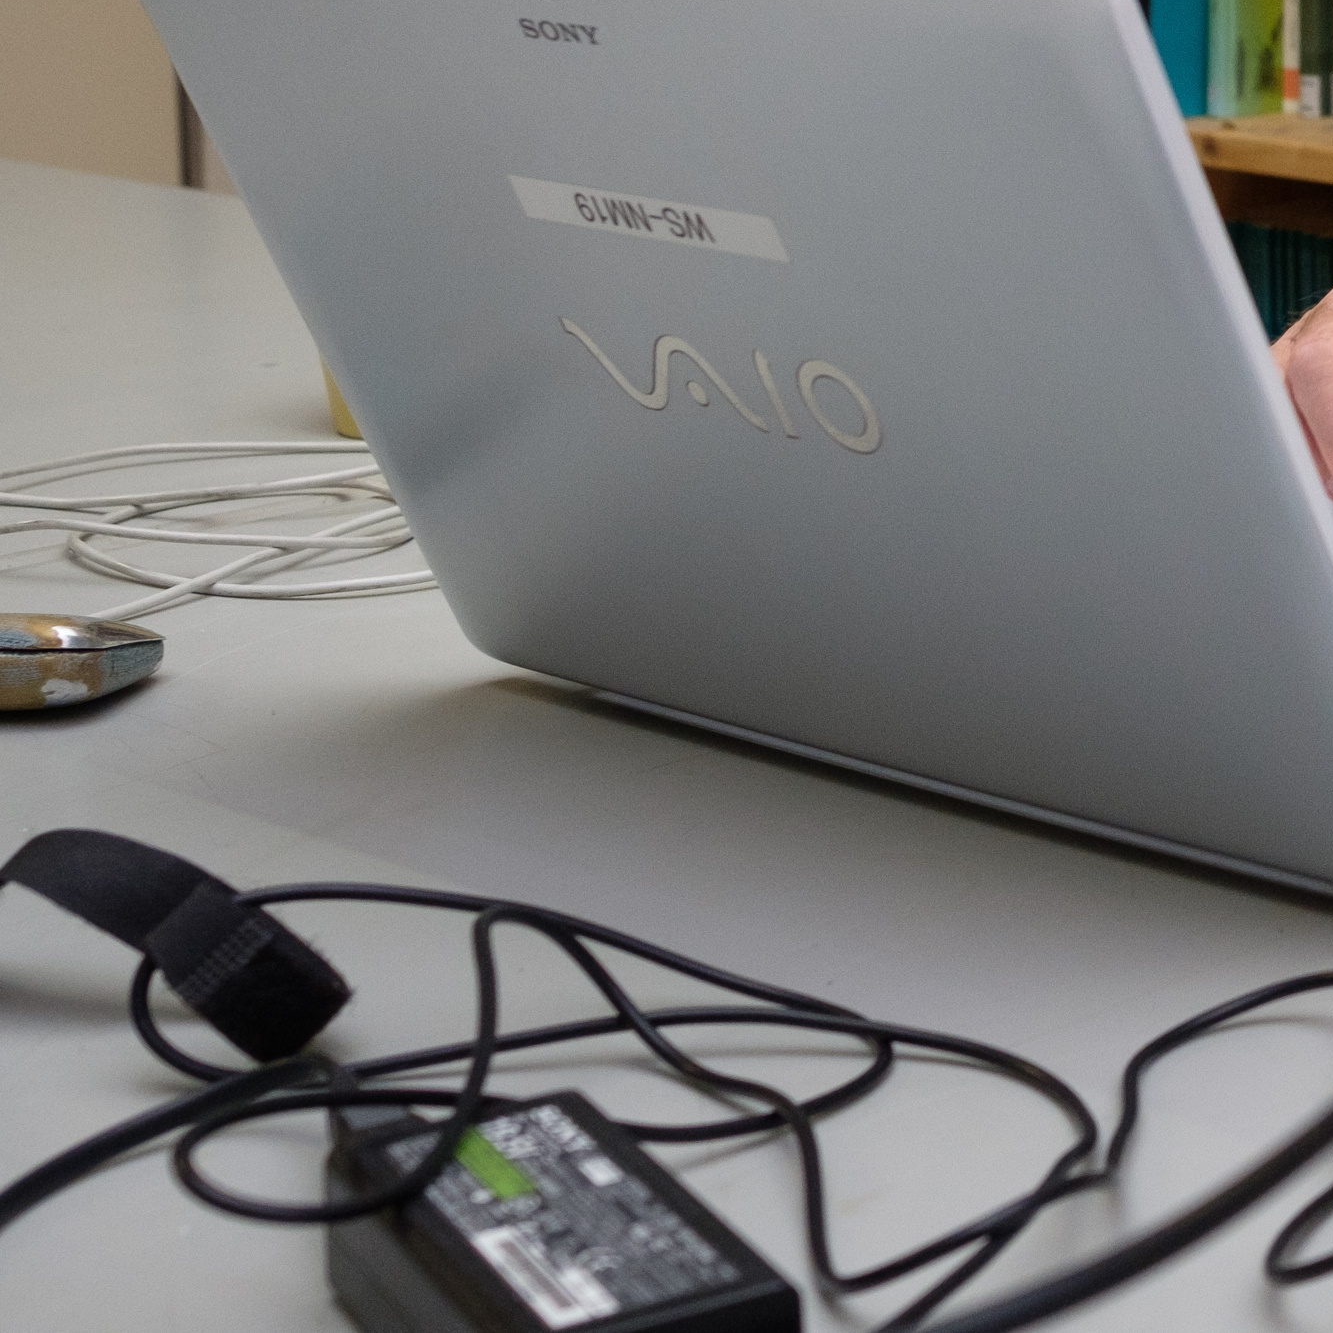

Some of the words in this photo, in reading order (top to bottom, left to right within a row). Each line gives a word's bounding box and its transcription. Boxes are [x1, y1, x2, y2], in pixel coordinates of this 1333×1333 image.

[518, 17, 600, 46] SONY
[573, 192, 716, 245] WS-NM19
[558, 316, 883, 456] VAIO
